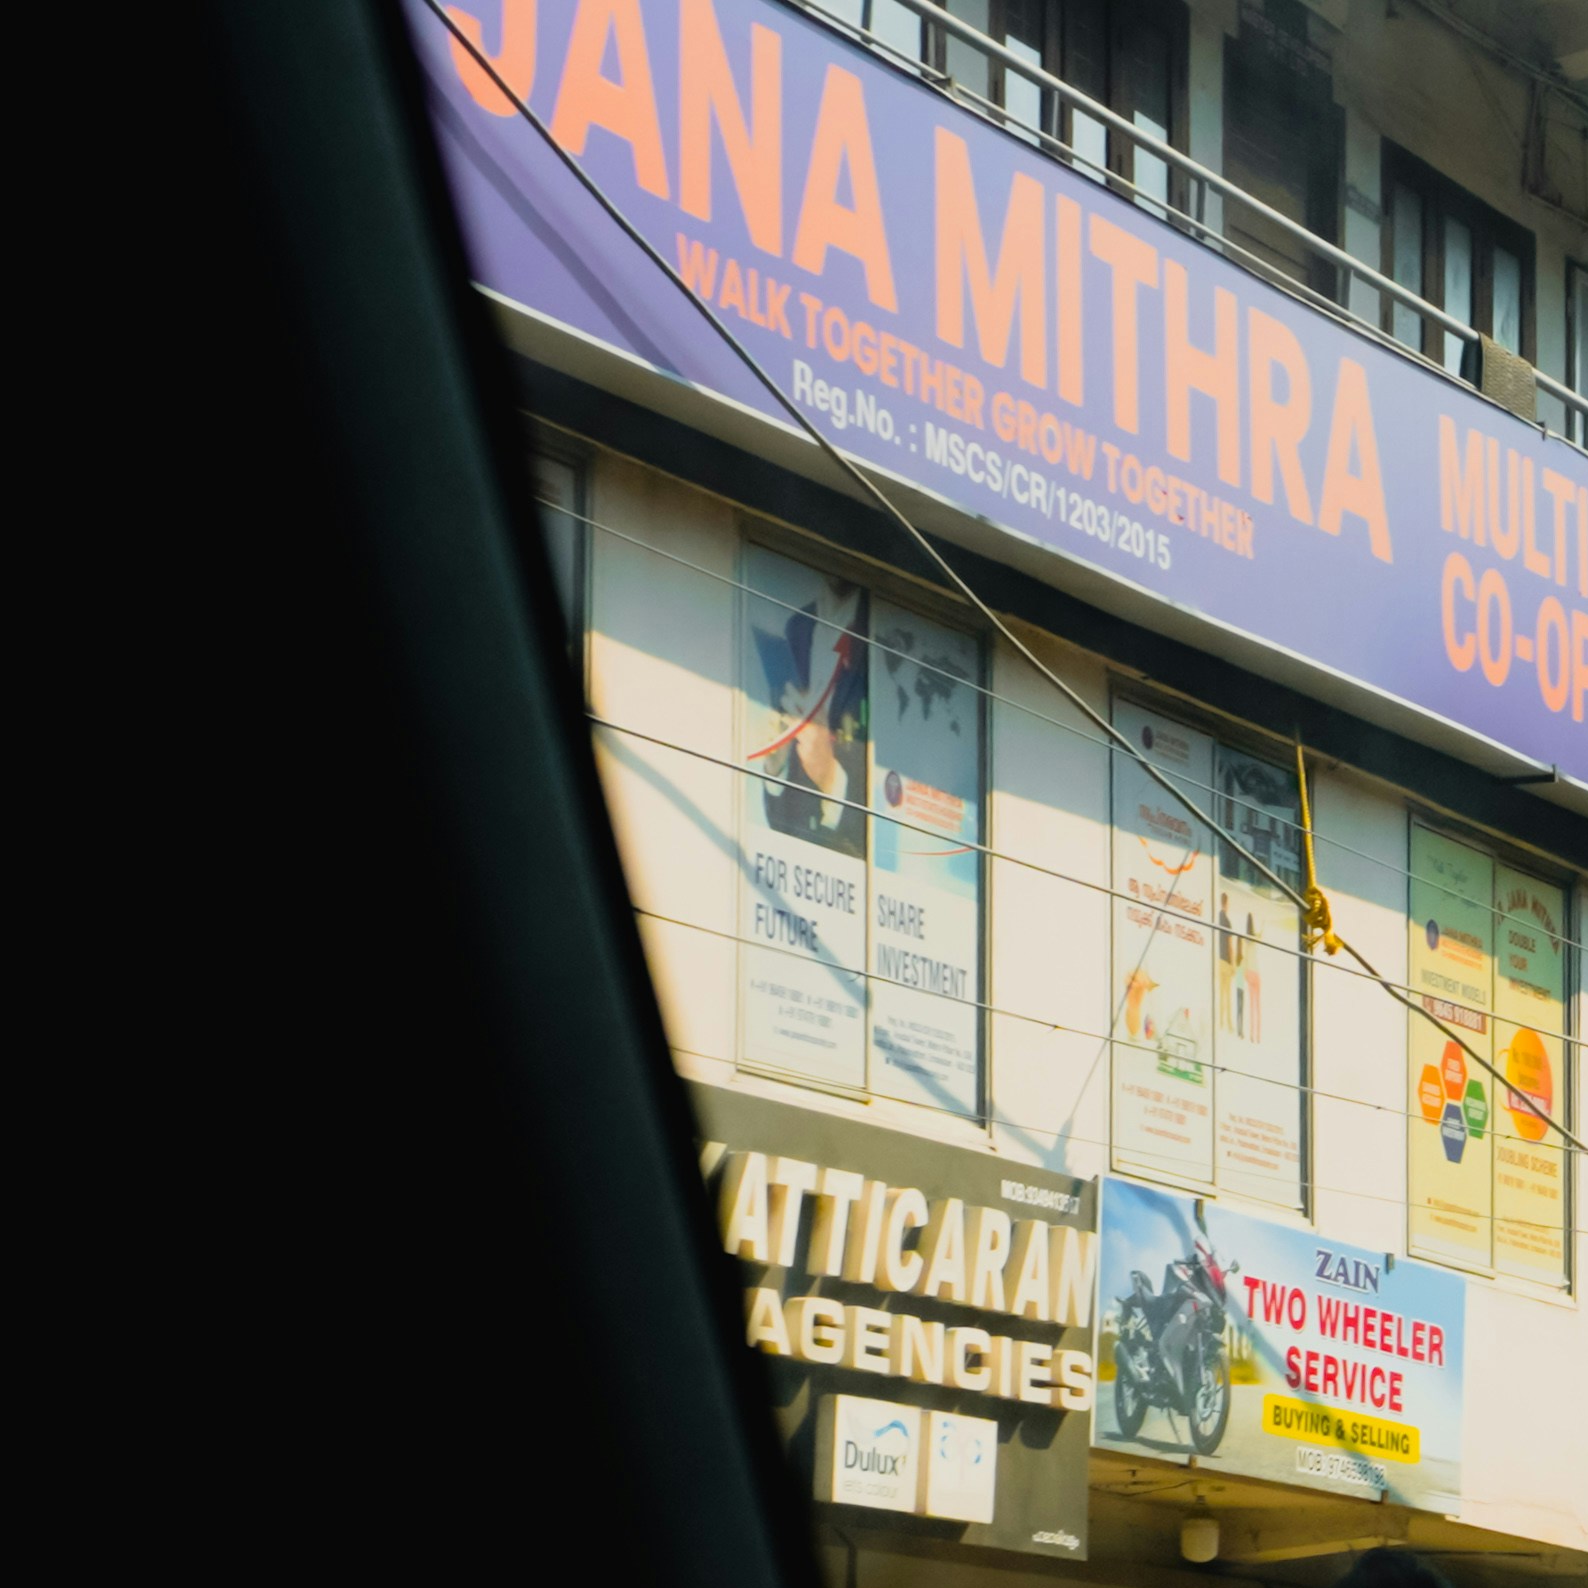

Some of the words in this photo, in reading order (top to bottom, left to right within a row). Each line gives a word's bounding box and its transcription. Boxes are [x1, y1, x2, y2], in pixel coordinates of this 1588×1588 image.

[934, 126, 1393, 564] MITHRA
[677, 232, 792, 339] WALK
[800, 293, 985, 432] TOGETHER
[991, 392, 1095, 481] GROW
[1101, 441, 1255, 560] TOGETHER
[925, 431, 1172, 571] MSCS/CR/1203/2015
[755, 851, 788, 894] FOR
[793, 864, 856, 916] SECURE
[754, 902, 819, 953] FUTURE
[877, 893, 925, 941] SHARE
[876, 942, 968, 1000] INVESTMENT
[1315, 1249, 1381, 1293] ZAIN
[747, 1286, 1094, 1412] AGENCIES
[1243, 1275, 1307, 1332] TWO
[1317, 1294, 1445, 1366] WHEELER
[1284, 1345, 1404, 1412] SERVICE
[843, 1440, 900, 1477] Dulux
[1272, 1404, 1332, 1437] BUYING
[1335, 1421, 1346, 1441] &
[1350, 1421, 1411, 1455] SELLING
